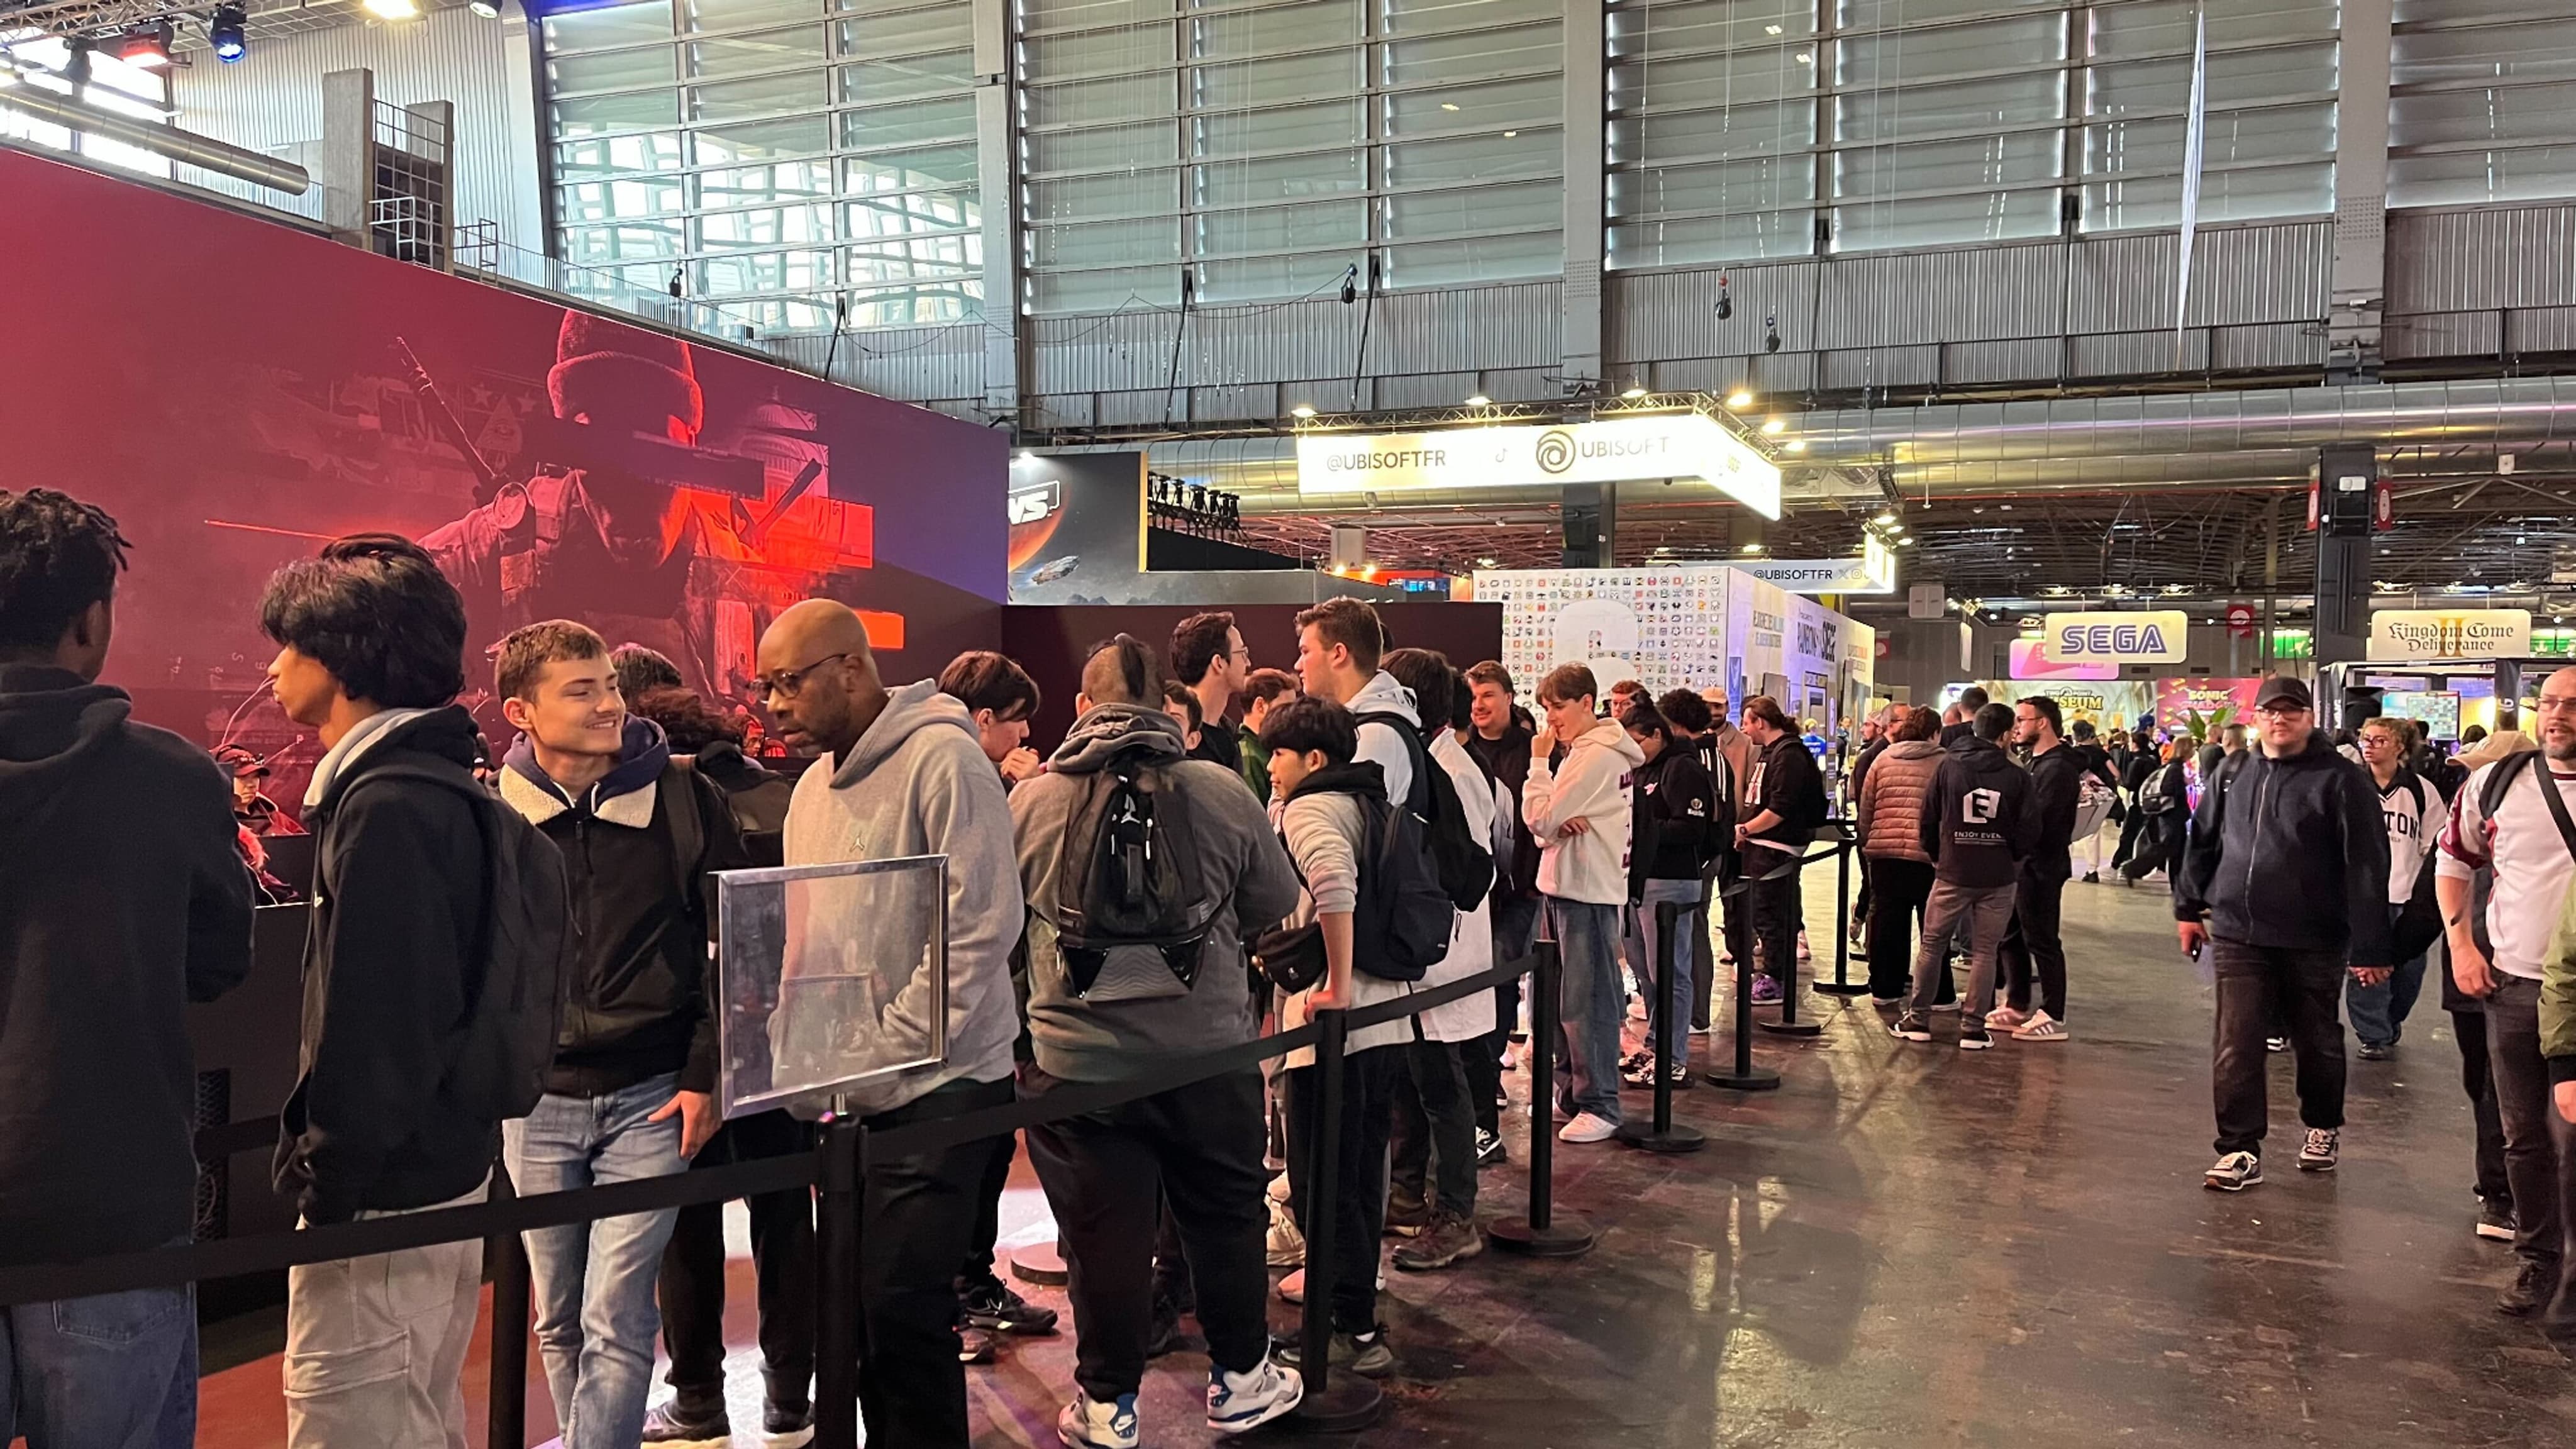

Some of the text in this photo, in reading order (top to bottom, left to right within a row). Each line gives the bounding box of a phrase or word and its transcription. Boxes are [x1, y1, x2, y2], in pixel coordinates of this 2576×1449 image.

[1581, 436, 1669, 458] UBISOFT
[1327, 449, 1446, 471] @UBISOFTFR
[1753, 569, 1833, 580] @UBISOFTFR
[2389, 622, 2514, 640] Kingdom Come
[2061, 624, 2167, 655] SEGA
[2408, 638, 2494, 652] Deliverance
[2053, 696, 2103, 709] SEUM
[2188, 690, 2228, 701] SONIC
